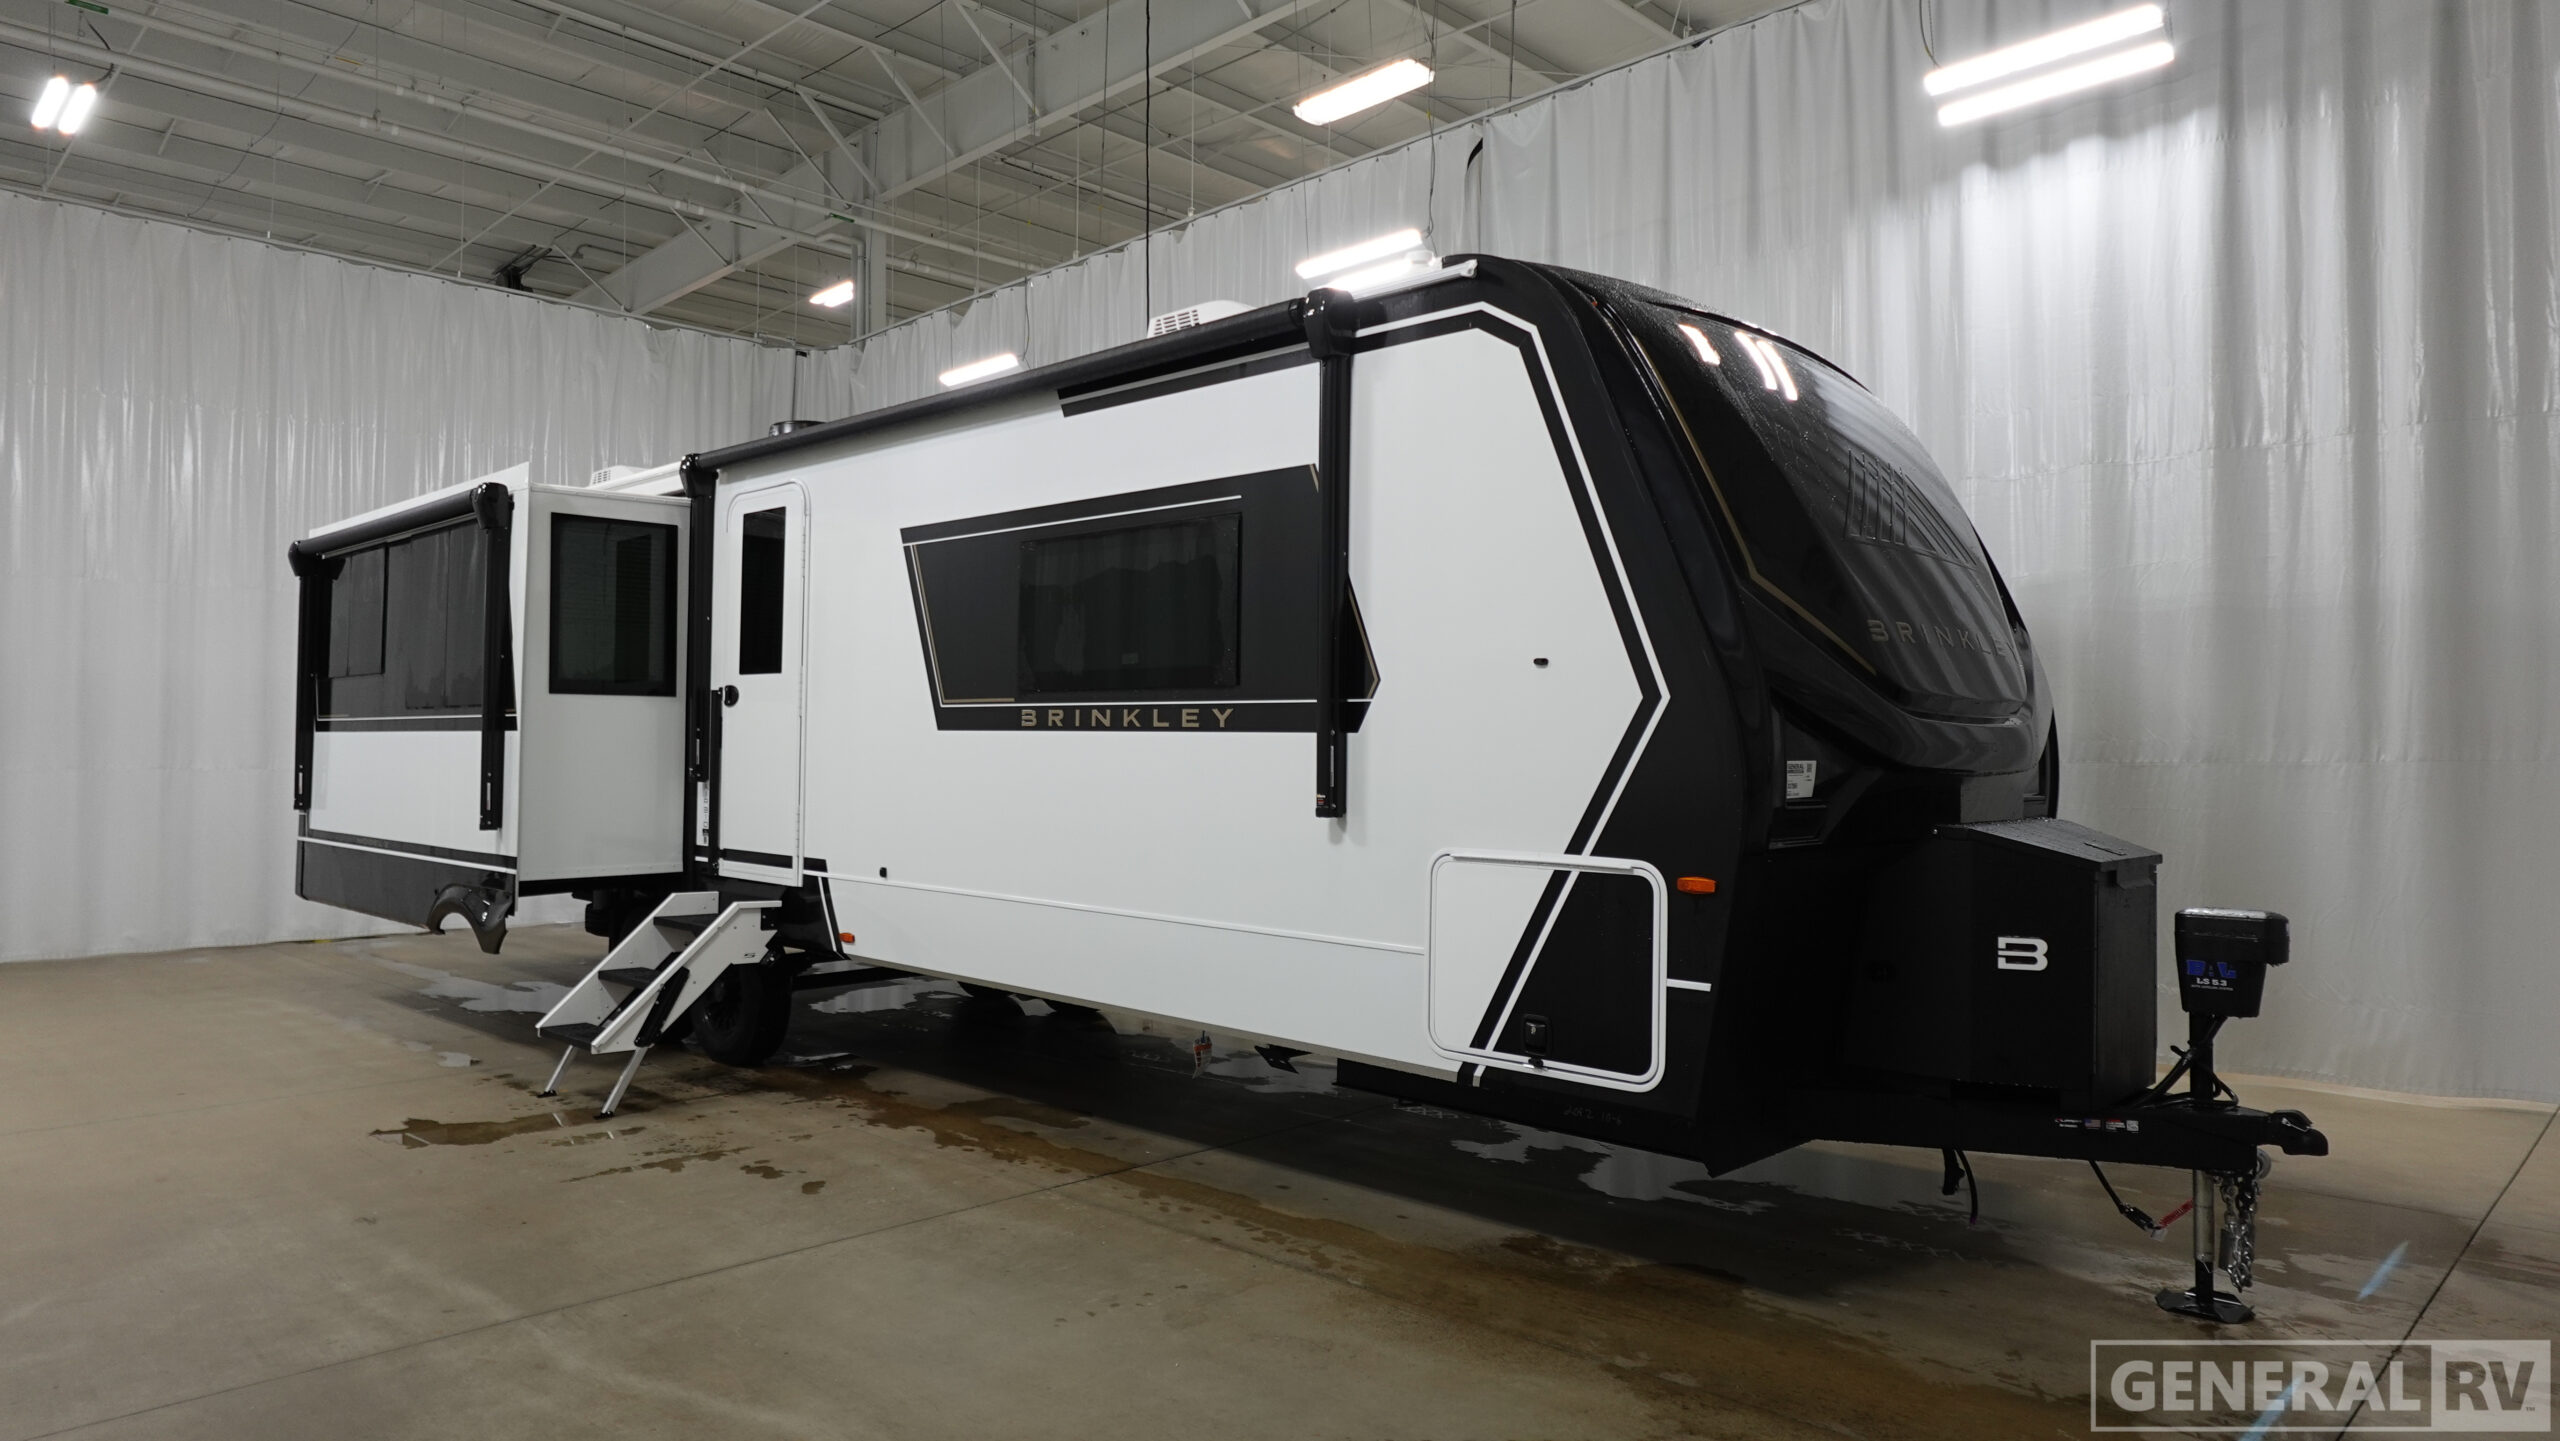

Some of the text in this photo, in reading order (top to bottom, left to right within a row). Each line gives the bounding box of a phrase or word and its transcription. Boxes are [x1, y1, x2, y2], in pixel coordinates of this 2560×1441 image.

[1867, 619, 2019, 665] BRINKLEY
[1021, 708, 1234, 728] BRINKLEY
[2196, 977, 2210, 985] LS
